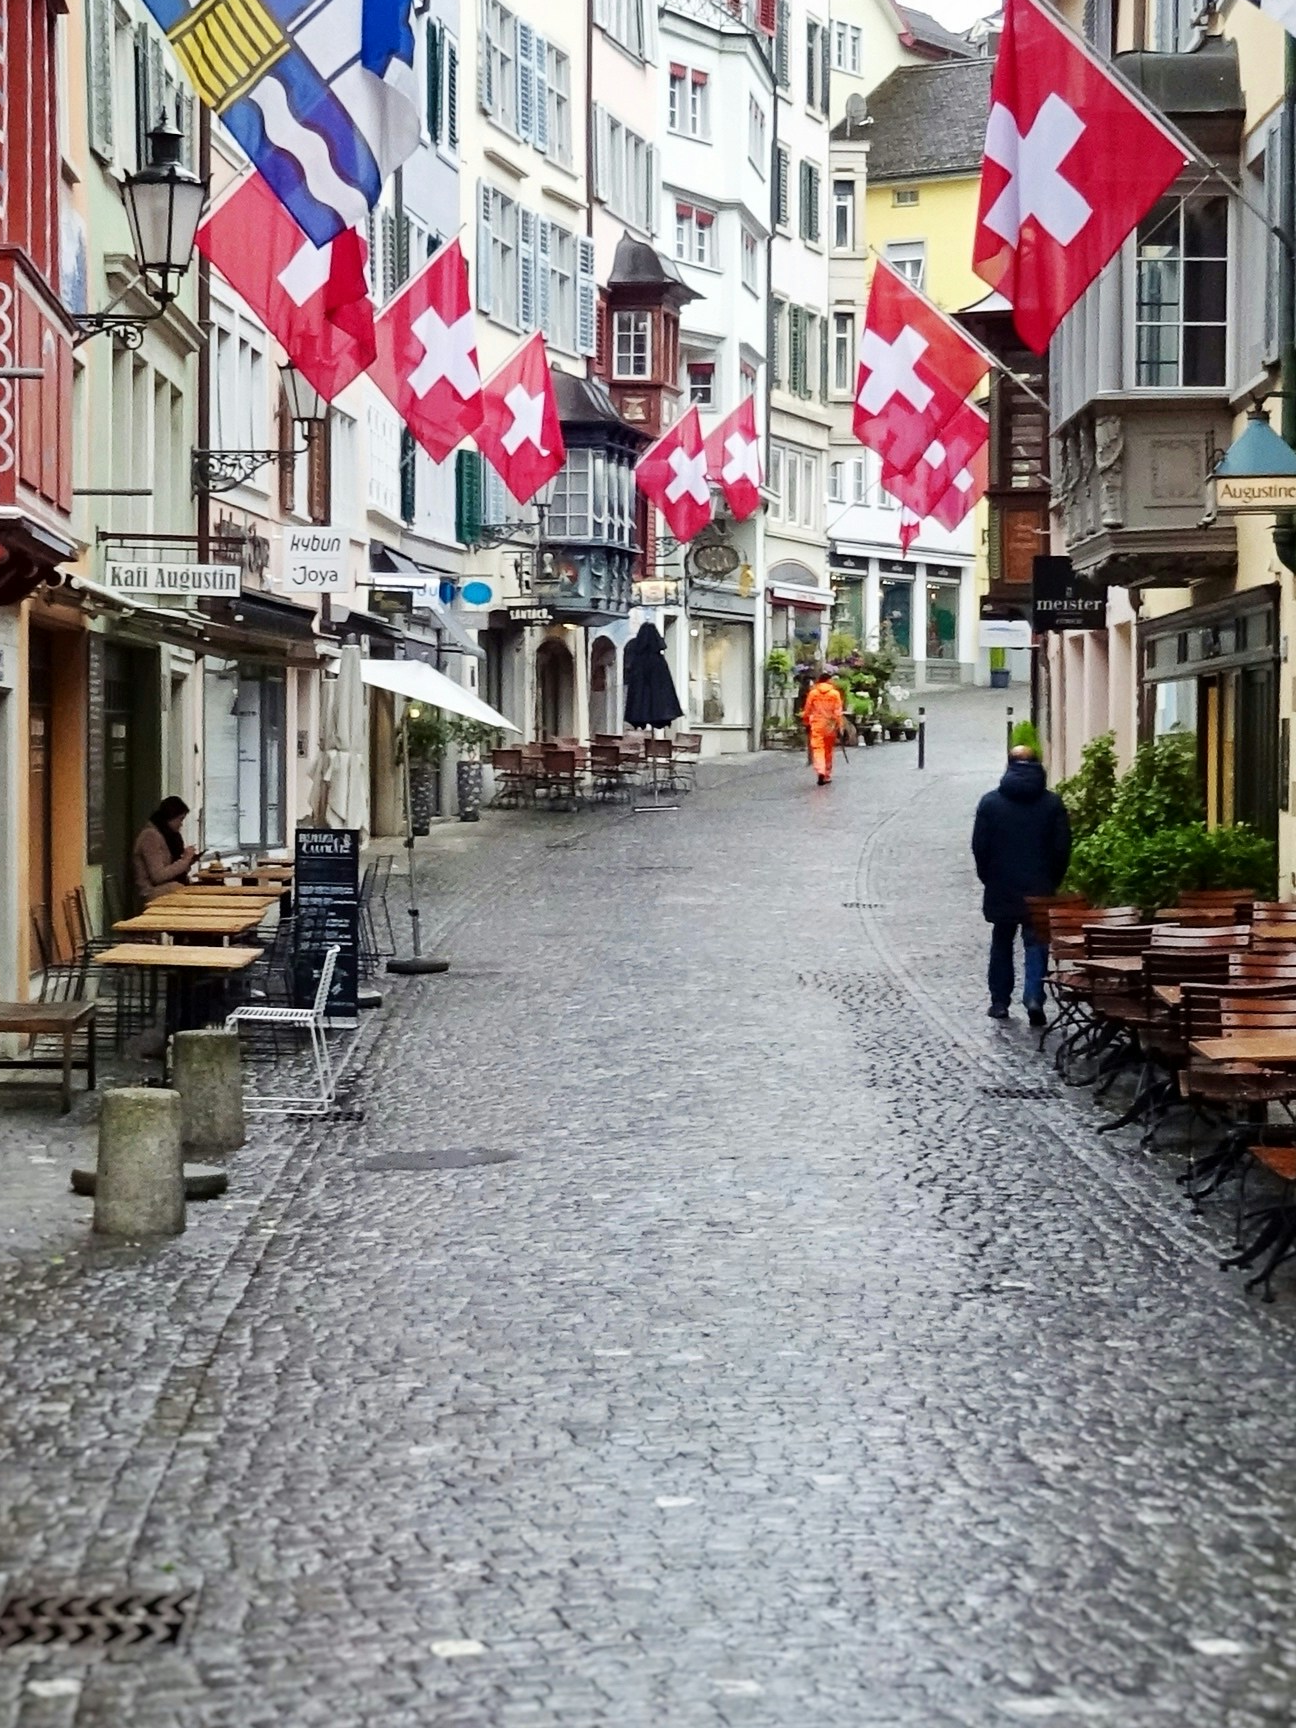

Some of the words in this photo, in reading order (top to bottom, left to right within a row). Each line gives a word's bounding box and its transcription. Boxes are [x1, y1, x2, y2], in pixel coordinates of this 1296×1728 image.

[290, 534, 341, 552] kybun
[110, 566, 148, 588] Kafi
[156, 567, 236, 591] Augustin
[1036, 598, 1103, 611] meister
